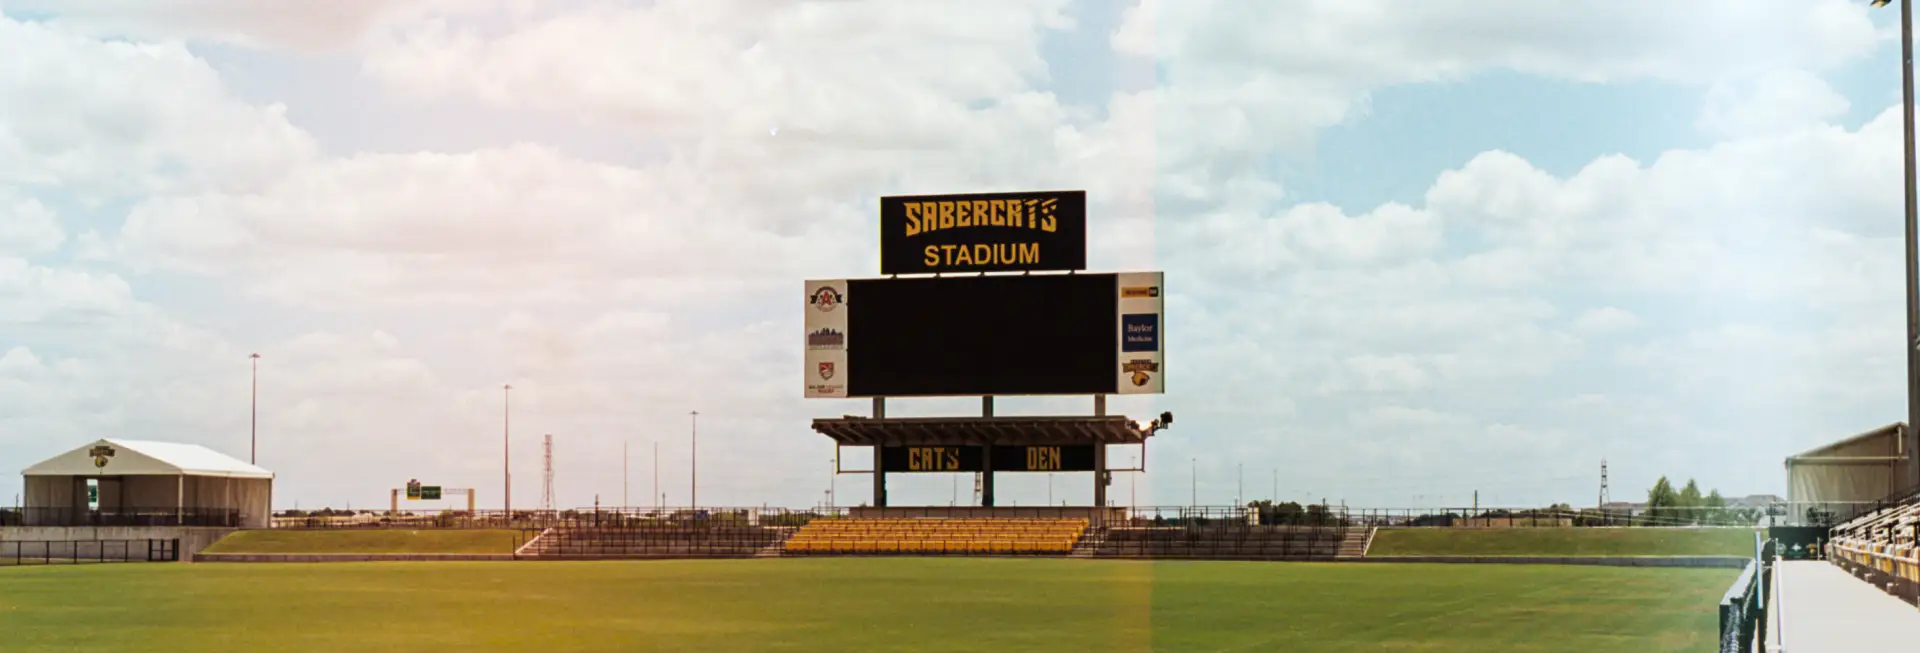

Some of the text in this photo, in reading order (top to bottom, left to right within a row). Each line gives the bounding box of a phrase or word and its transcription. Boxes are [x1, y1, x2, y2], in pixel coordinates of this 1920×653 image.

[903, 198, 1058, 237] SABERCATS
[924, 242, 1040, 267] STADIUM
[908, 447, 959, 470] CATS
[1027, 446, 1061, 470] DEN
